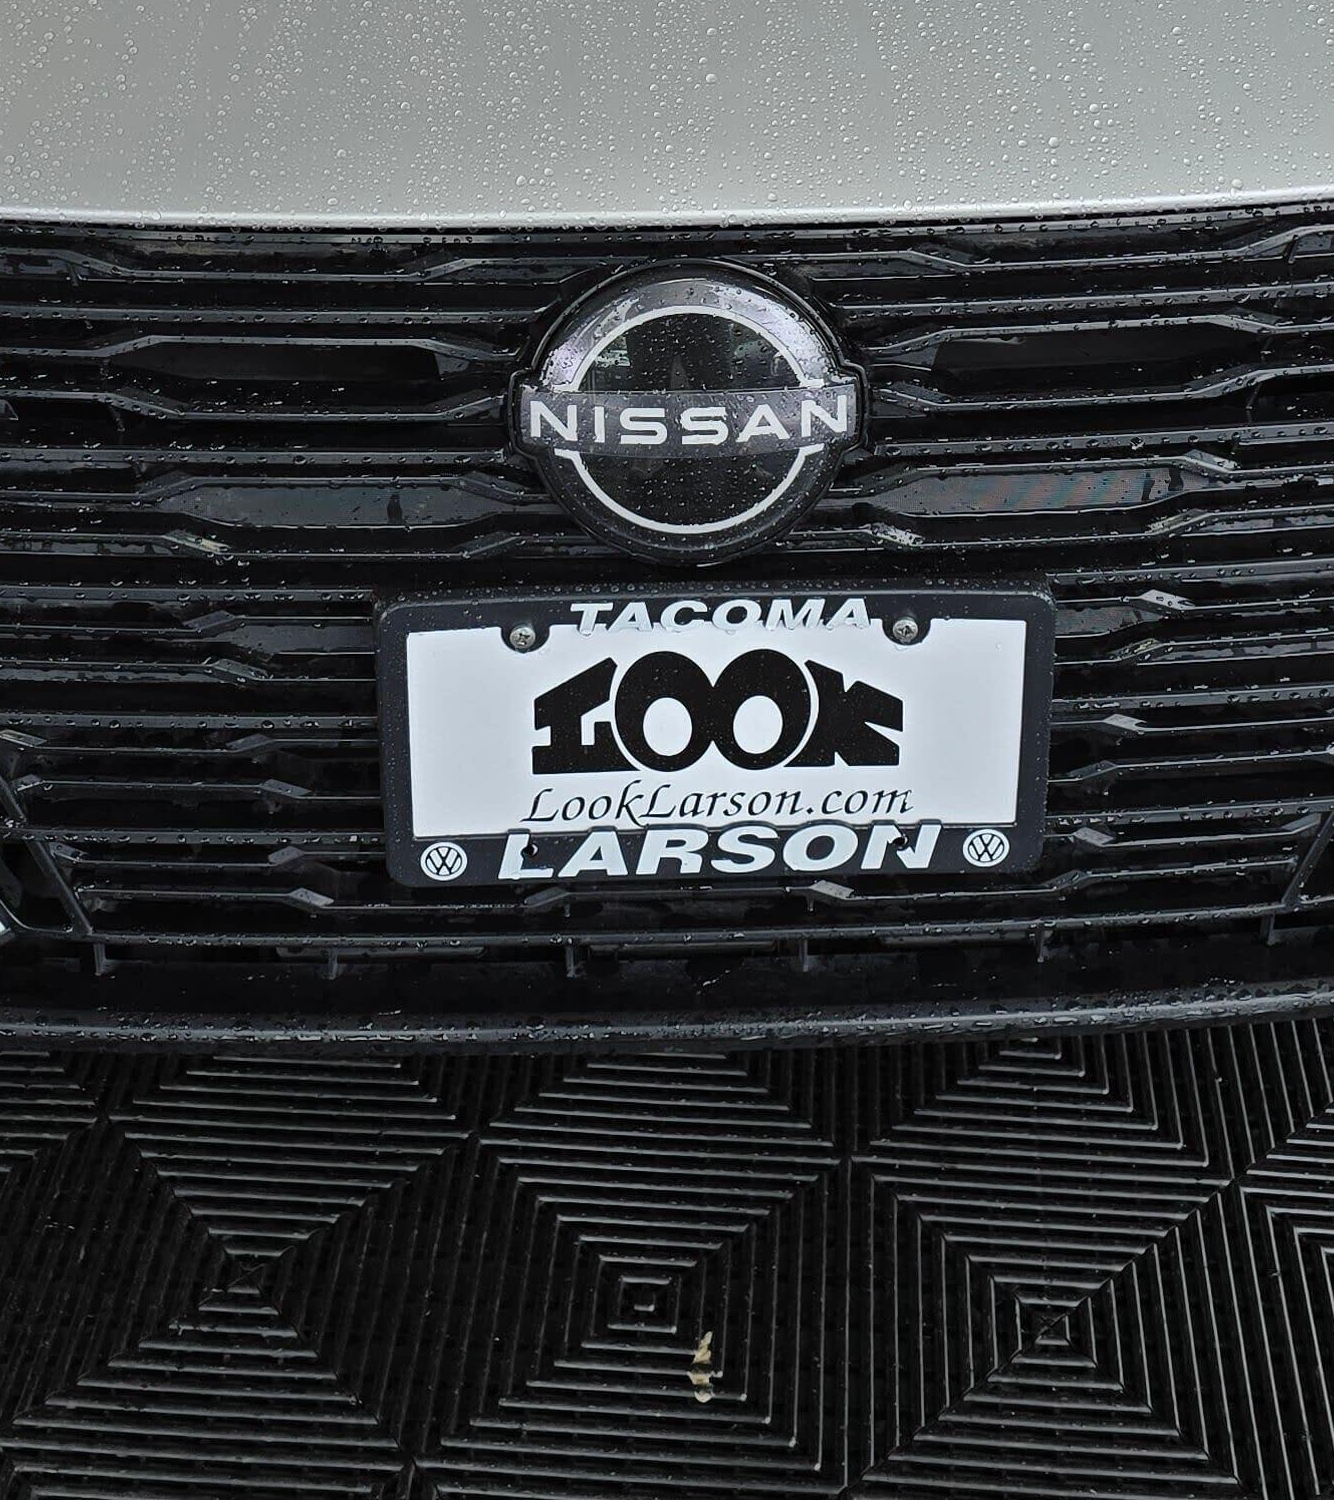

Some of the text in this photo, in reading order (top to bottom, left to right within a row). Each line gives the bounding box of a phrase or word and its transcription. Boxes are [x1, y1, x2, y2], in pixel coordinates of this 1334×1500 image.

[529, 394, 848, 446] NISSAN
[569, 598, 872, 635] TACOMA
[531, 648, 904, 775] LOOK
[520, 779, 914, 828] LookLarson.com
[497, 824, 943, 880] LARSON
